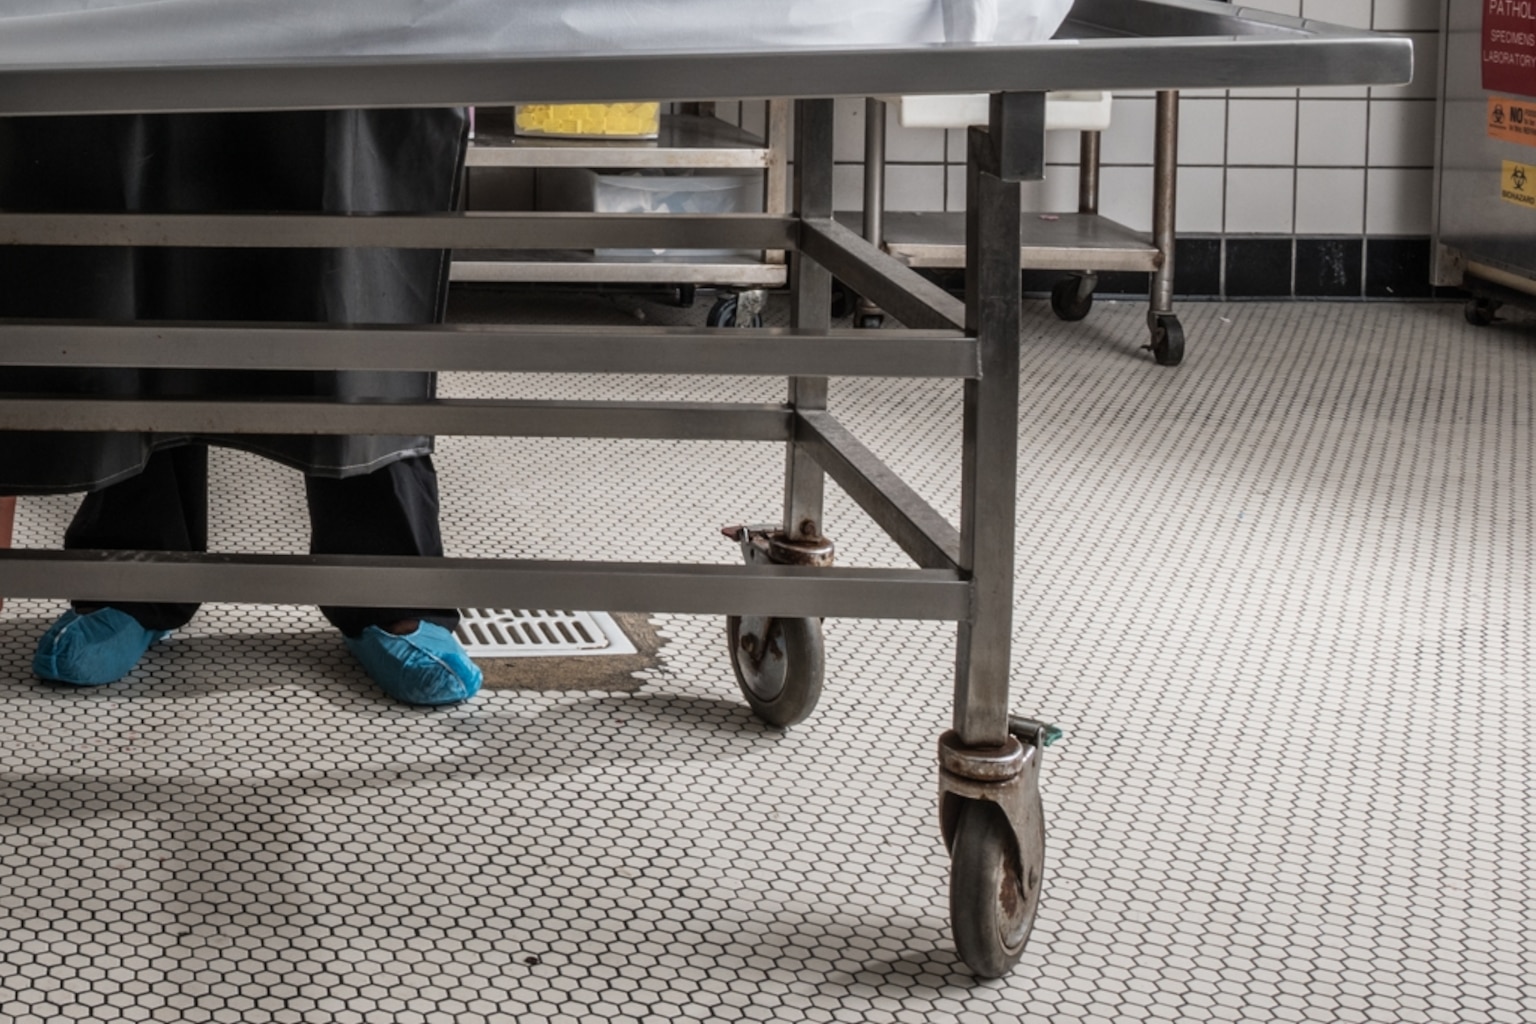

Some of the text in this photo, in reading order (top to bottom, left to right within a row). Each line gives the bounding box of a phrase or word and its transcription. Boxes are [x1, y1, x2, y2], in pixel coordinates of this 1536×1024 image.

[1490, 29, 1536, 47] SPECIMENS
[1483, 49, 1536, 68] LABORATORY
[1510, 106, 1523, 124] NO
[1501, 189, 1536, 206] BIOHAZARD
